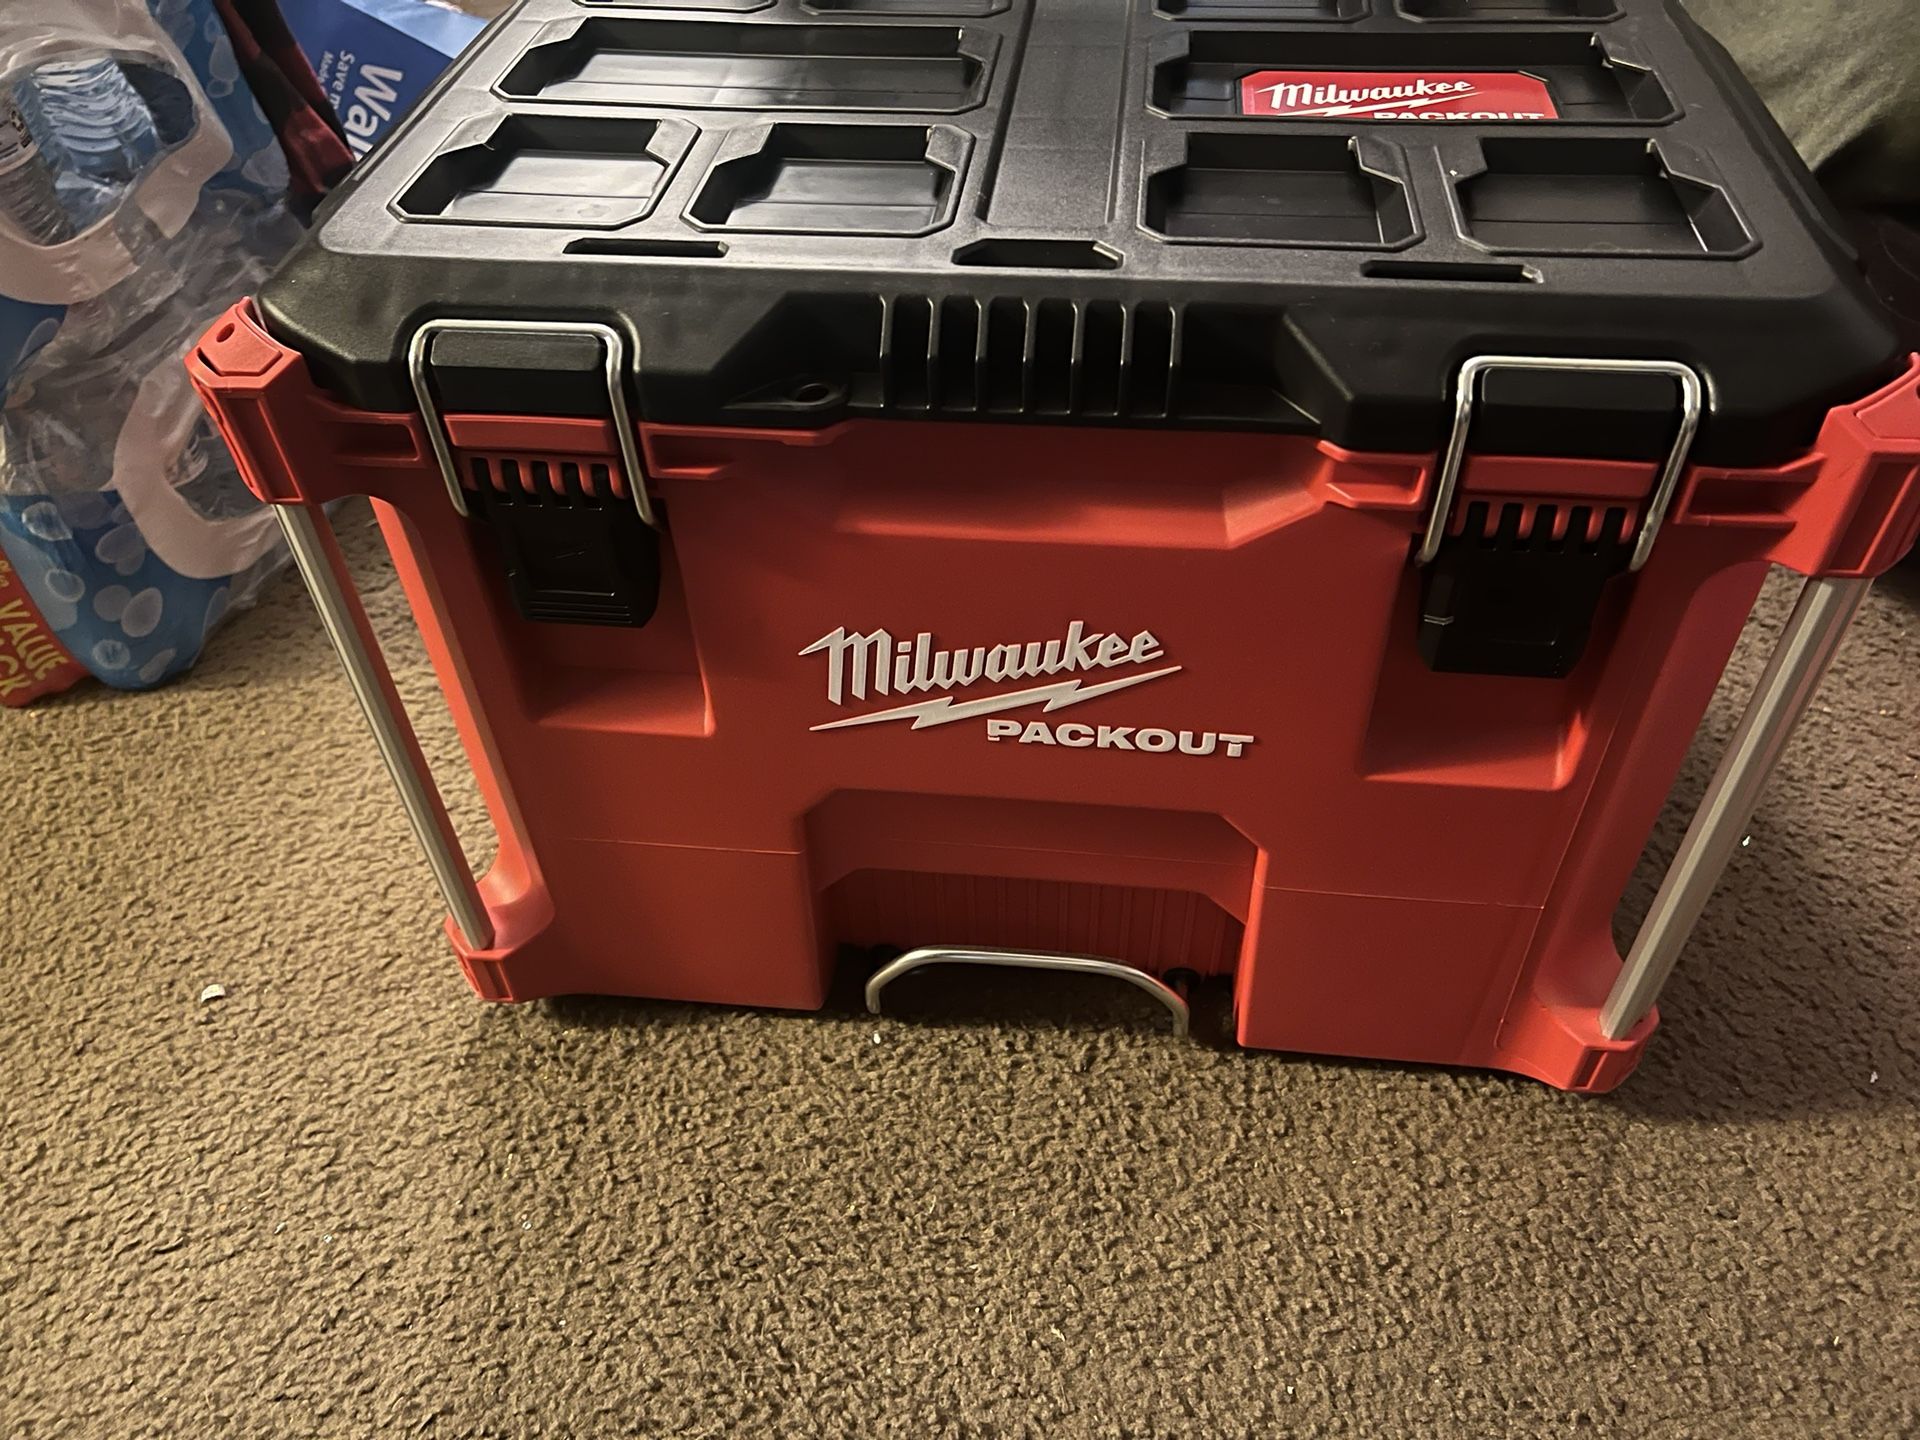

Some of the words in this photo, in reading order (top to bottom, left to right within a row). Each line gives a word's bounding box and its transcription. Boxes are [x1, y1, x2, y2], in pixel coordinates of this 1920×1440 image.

[332, 50, 355, 91] Save
[1255, 79, 1476, 110] Milwaukee
[343, 64, 403, 162] Wal
[0, 599, 69, 680] VALUE
[799, 620, 1164, 706] Milwaukee
[986, 718, 1255, 758] PACKOUT
